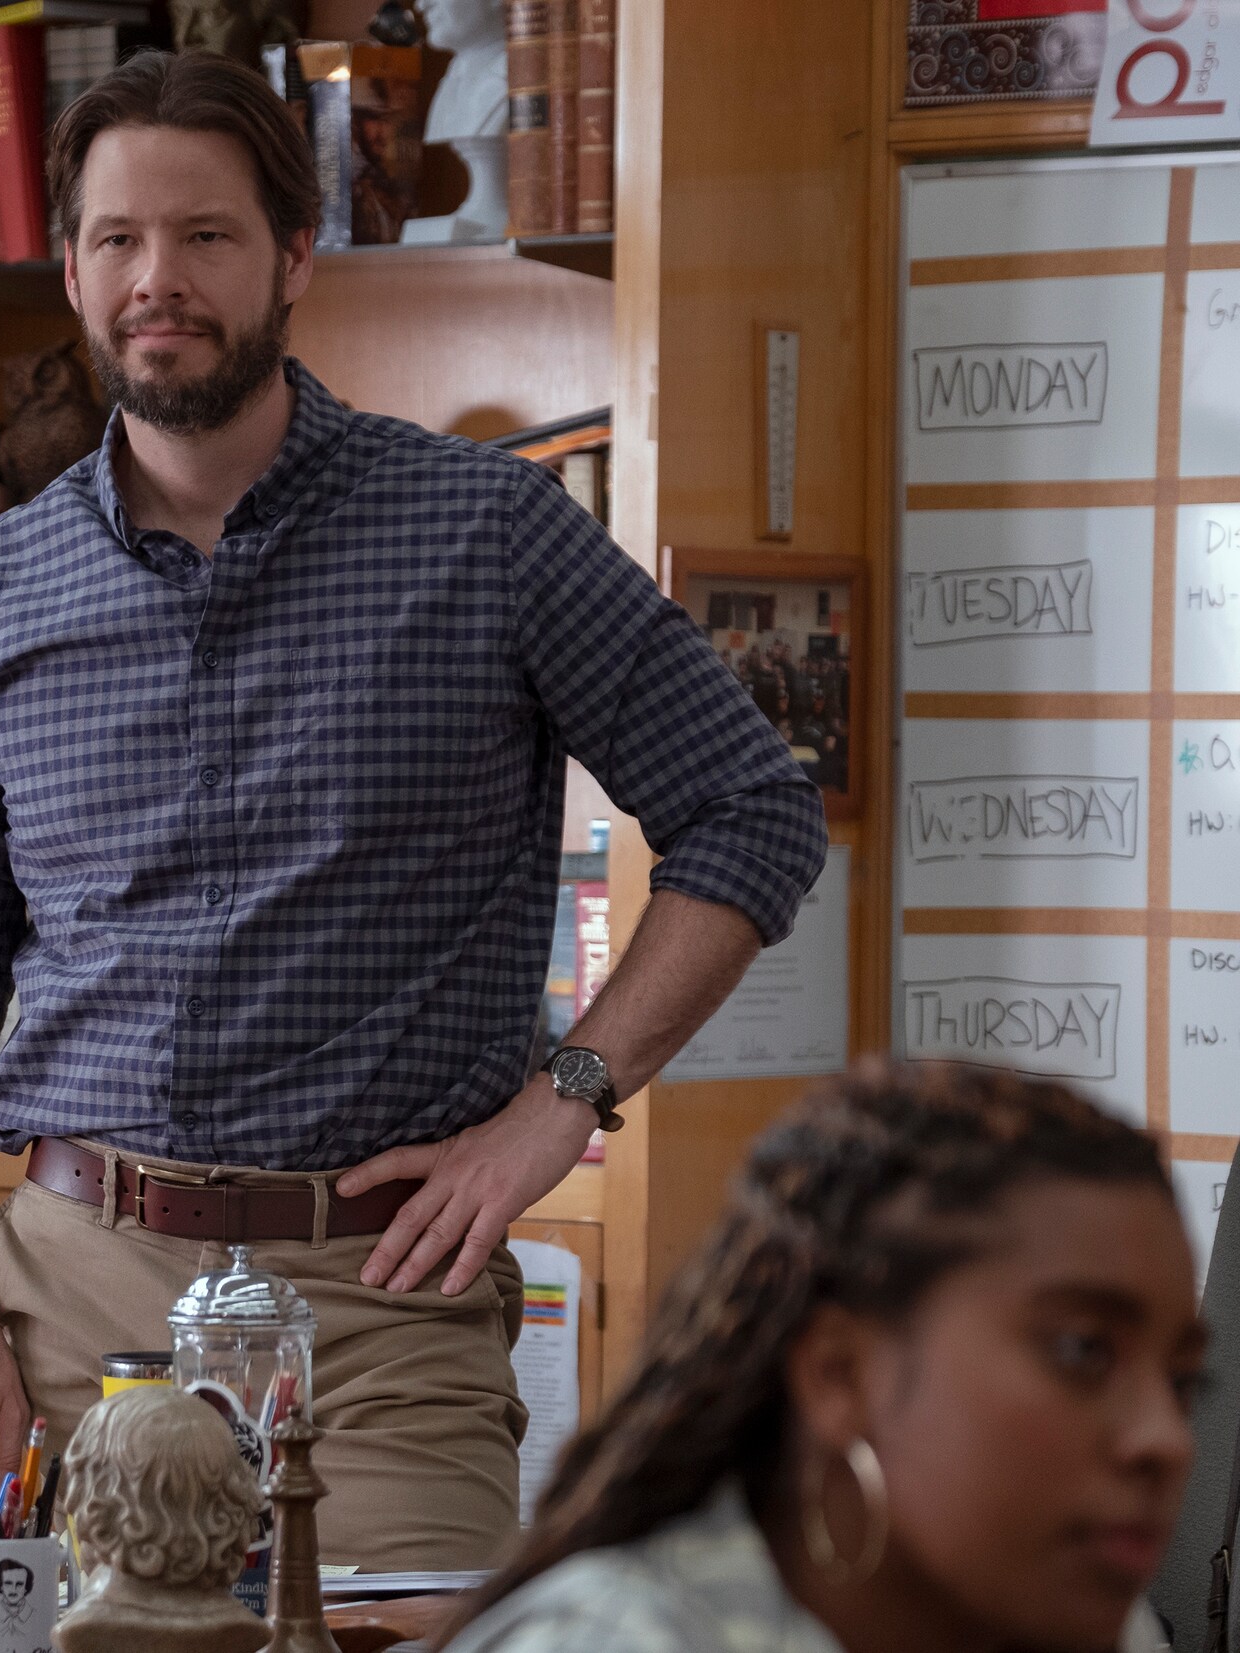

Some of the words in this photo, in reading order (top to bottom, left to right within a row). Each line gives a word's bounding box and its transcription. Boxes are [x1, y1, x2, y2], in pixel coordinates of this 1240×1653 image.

[1194, 40, 1220, 95] edgar
[927, 353, 1097, 419] MONDAY
[232, 1582, 268, 1595] Kindly
